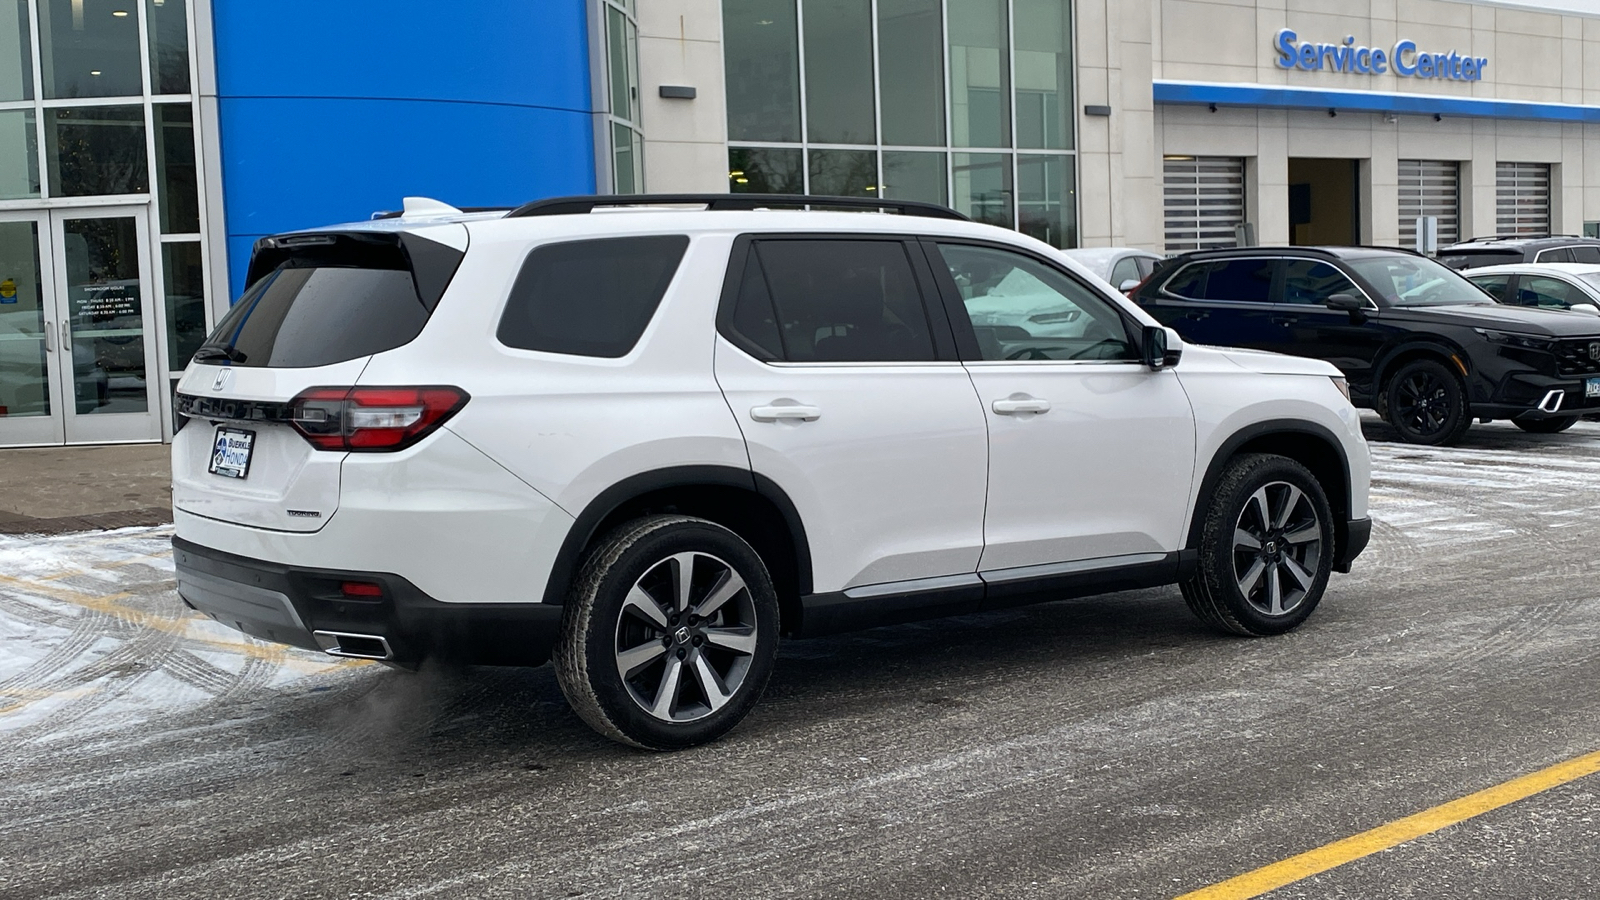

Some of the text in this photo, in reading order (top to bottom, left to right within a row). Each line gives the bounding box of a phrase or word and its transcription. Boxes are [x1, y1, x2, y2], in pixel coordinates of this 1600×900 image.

[1275, 28, 1488, 81] Service Center
[228, 438, 251, 450] BUERKLE
[225, 449, 248, 466] HONDA
